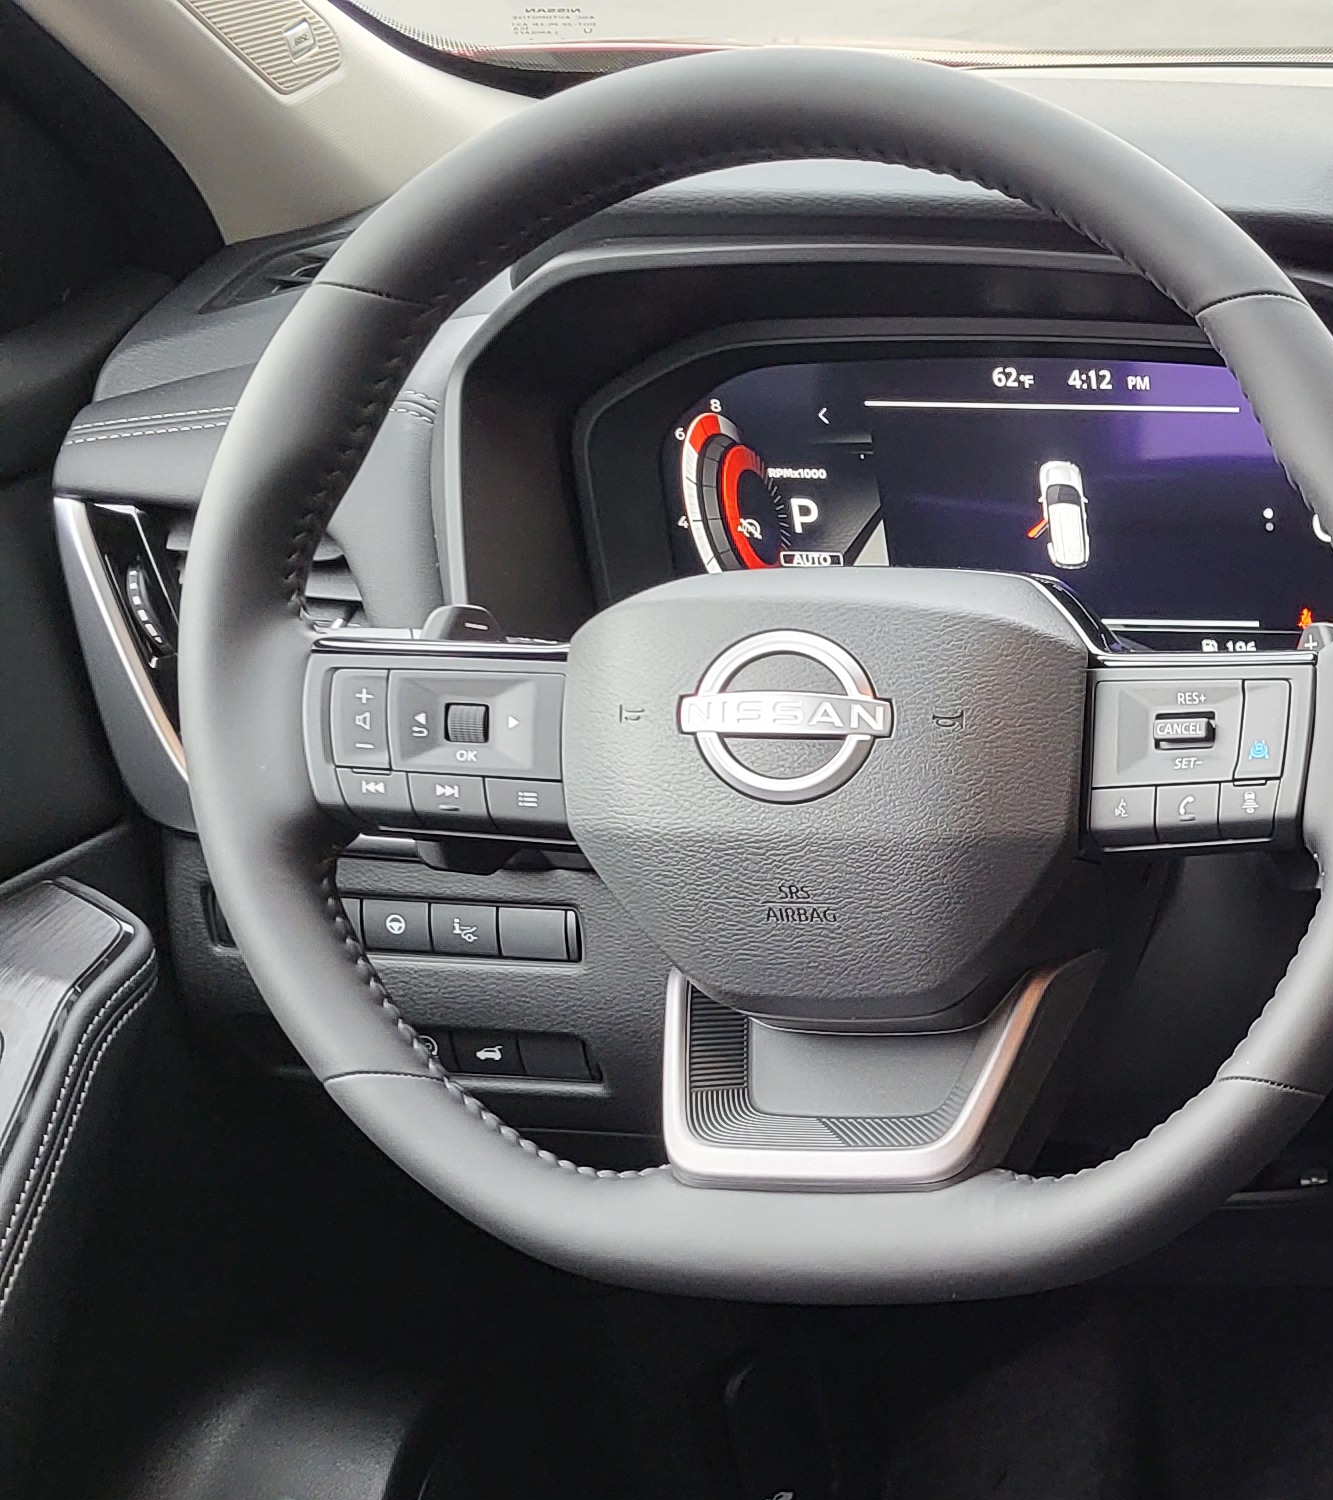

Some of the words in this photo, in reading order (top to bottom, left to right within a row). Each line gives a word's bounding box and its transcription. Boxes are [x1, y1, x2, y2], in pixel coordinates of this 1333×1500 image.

[1066, 368, 1113, 390] 4:12
[1126, 375, 1151, 391] PM
[710, 398, 723, 413] 8
[674, 427, 686, 441] 6
[677, 515, 689, 529] 4
[790, 497, 819, 534] P
[793, 553, 832, 565] AUTO
[1177, 692, 1207, 705] RES+
[687, 699, 885, 731] NISSAN
[1154, 722, 1203, 736] CANCEL
[455, 750, 478, 762] OK
[777, 884, 812, 899] SRS
[765, 907, 838, 923] AIRBAG
